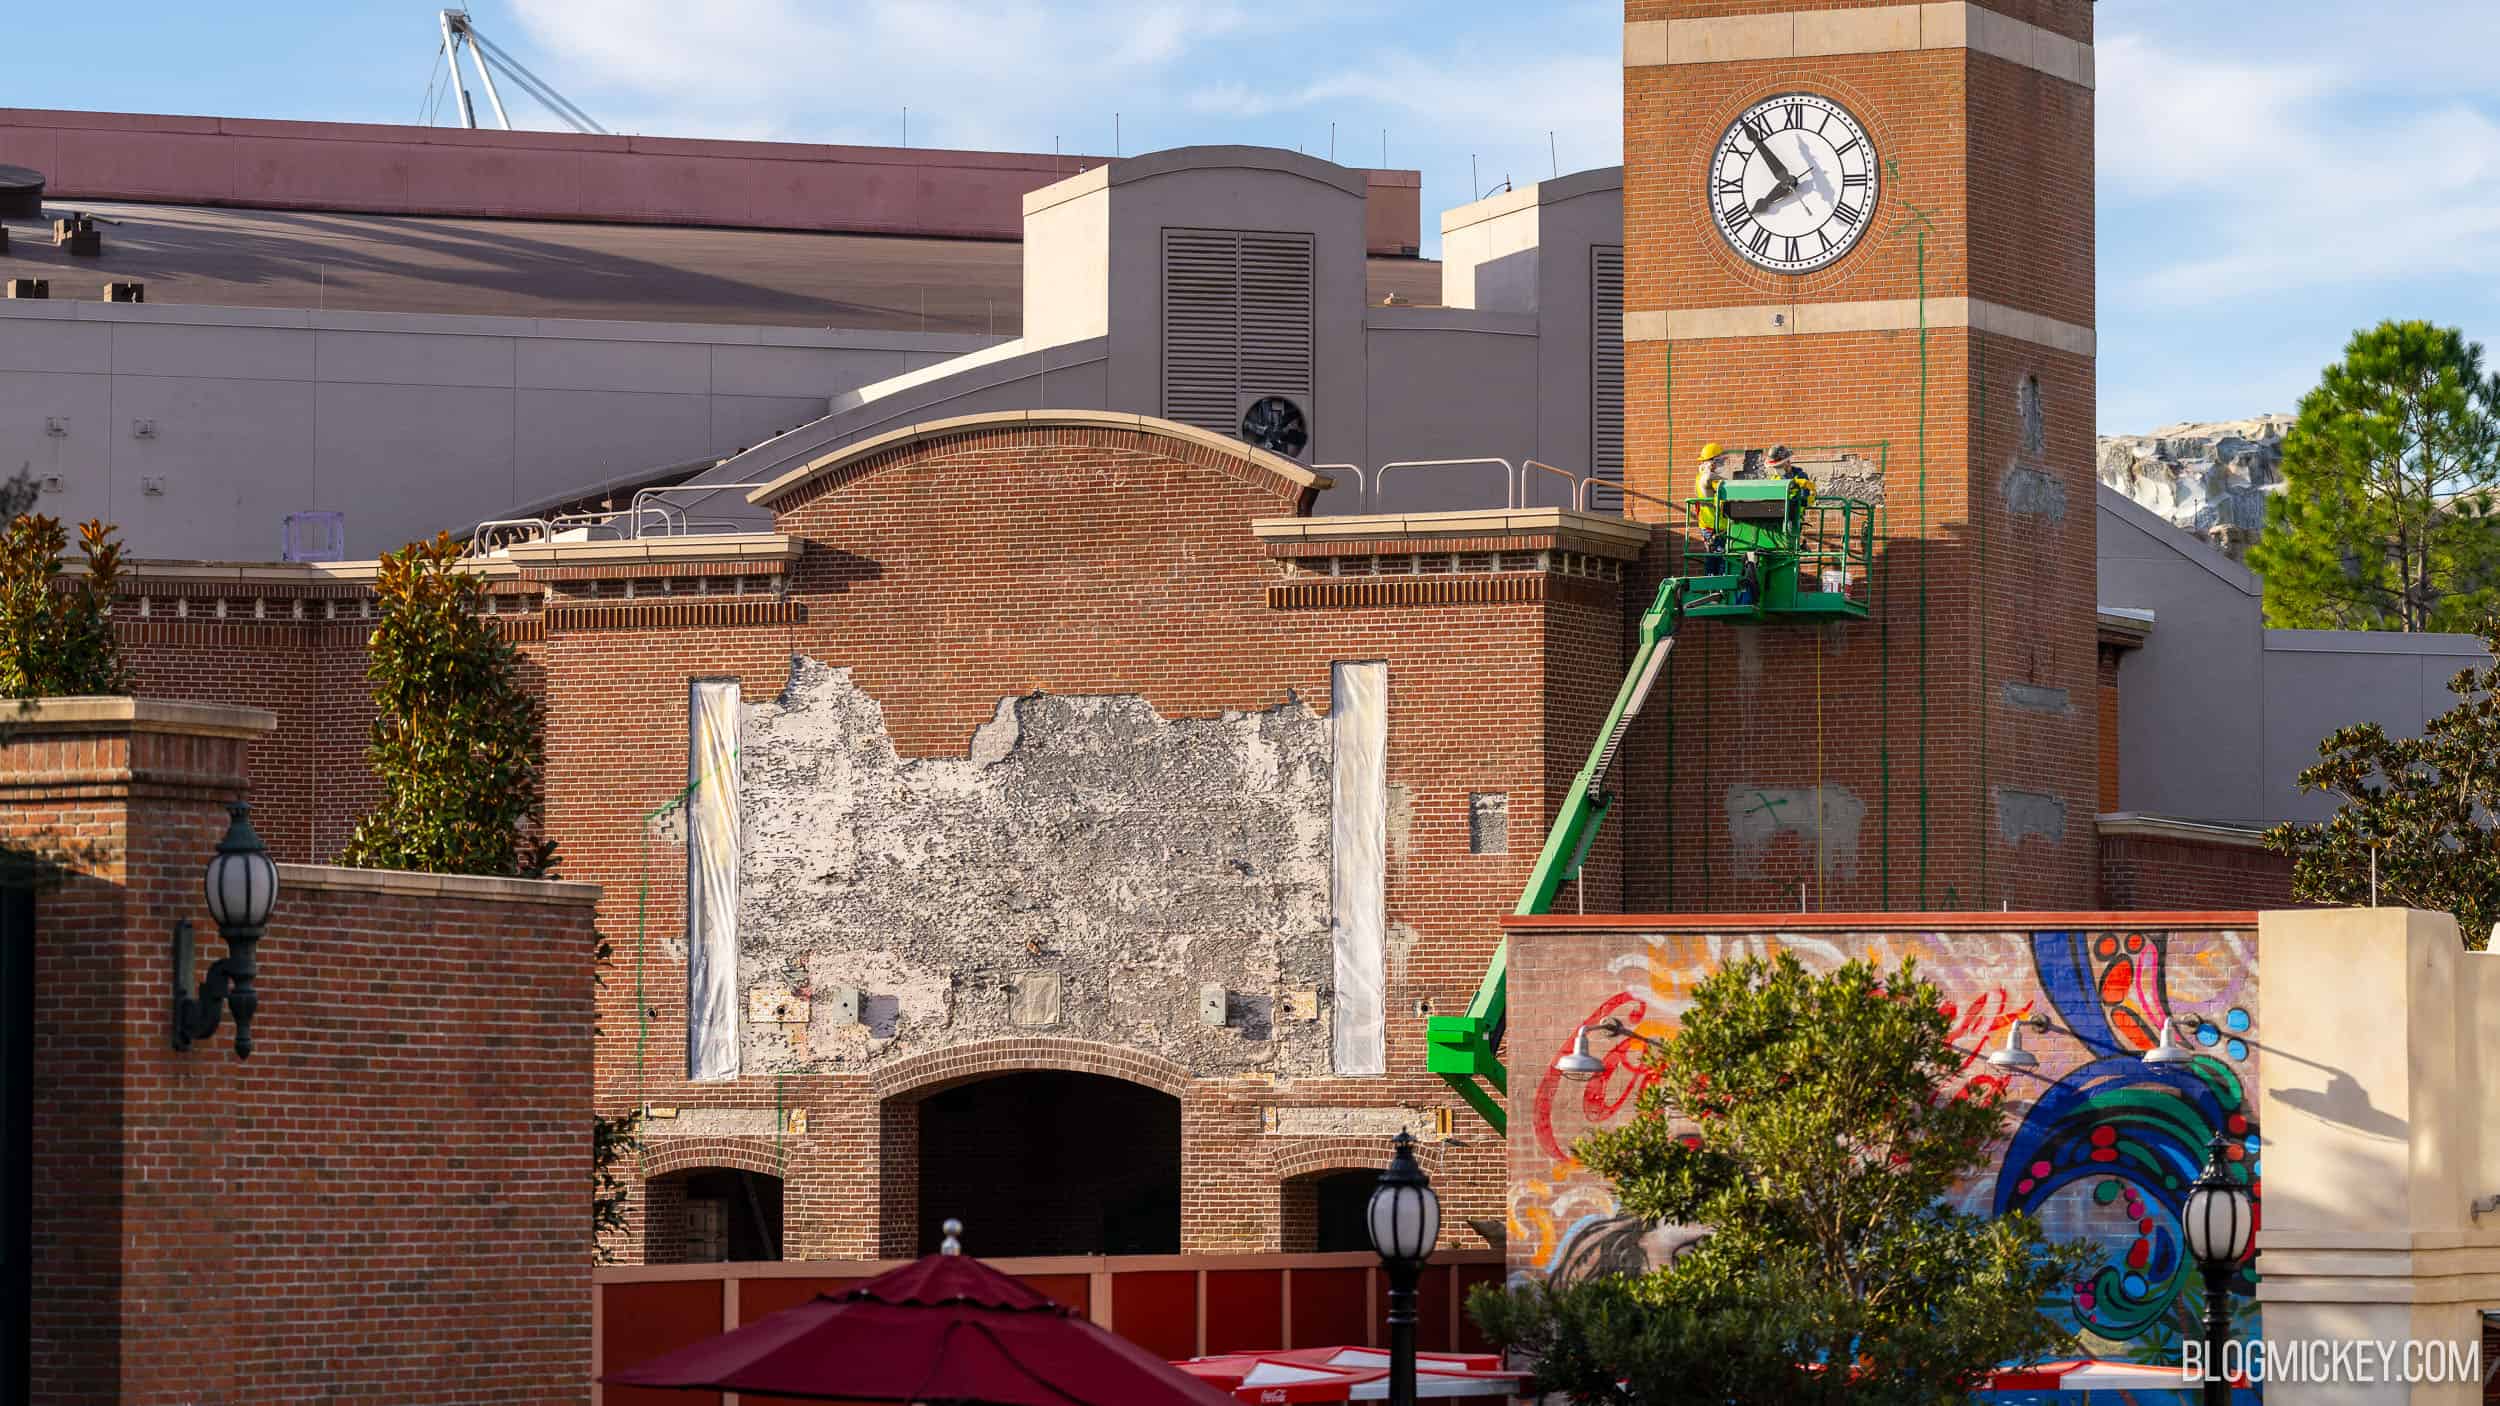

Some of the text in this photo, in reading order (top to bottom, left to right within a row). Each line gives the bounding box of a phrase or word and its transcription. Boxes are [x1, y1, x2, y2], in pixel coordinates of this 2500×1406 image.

[1750, 113, 1774, 141] XI
[1784, 104, 1803, 129] XII
[1818, 112, 1831, 135] I
[1727, 142, 1752, 162] X
[1836, 138, 1859, 156] II
[1719, 178, 1743, 193] IX
[1843, 174, 1867, 186] III
[1724, 202, 1752, 234] VIII
[1833, 201, 1860, 225] IIII
[1748, 226, 1772, 256] VII
[1784, 237, 1800, 261] VI
[1817, 229, 1833, 252] V
